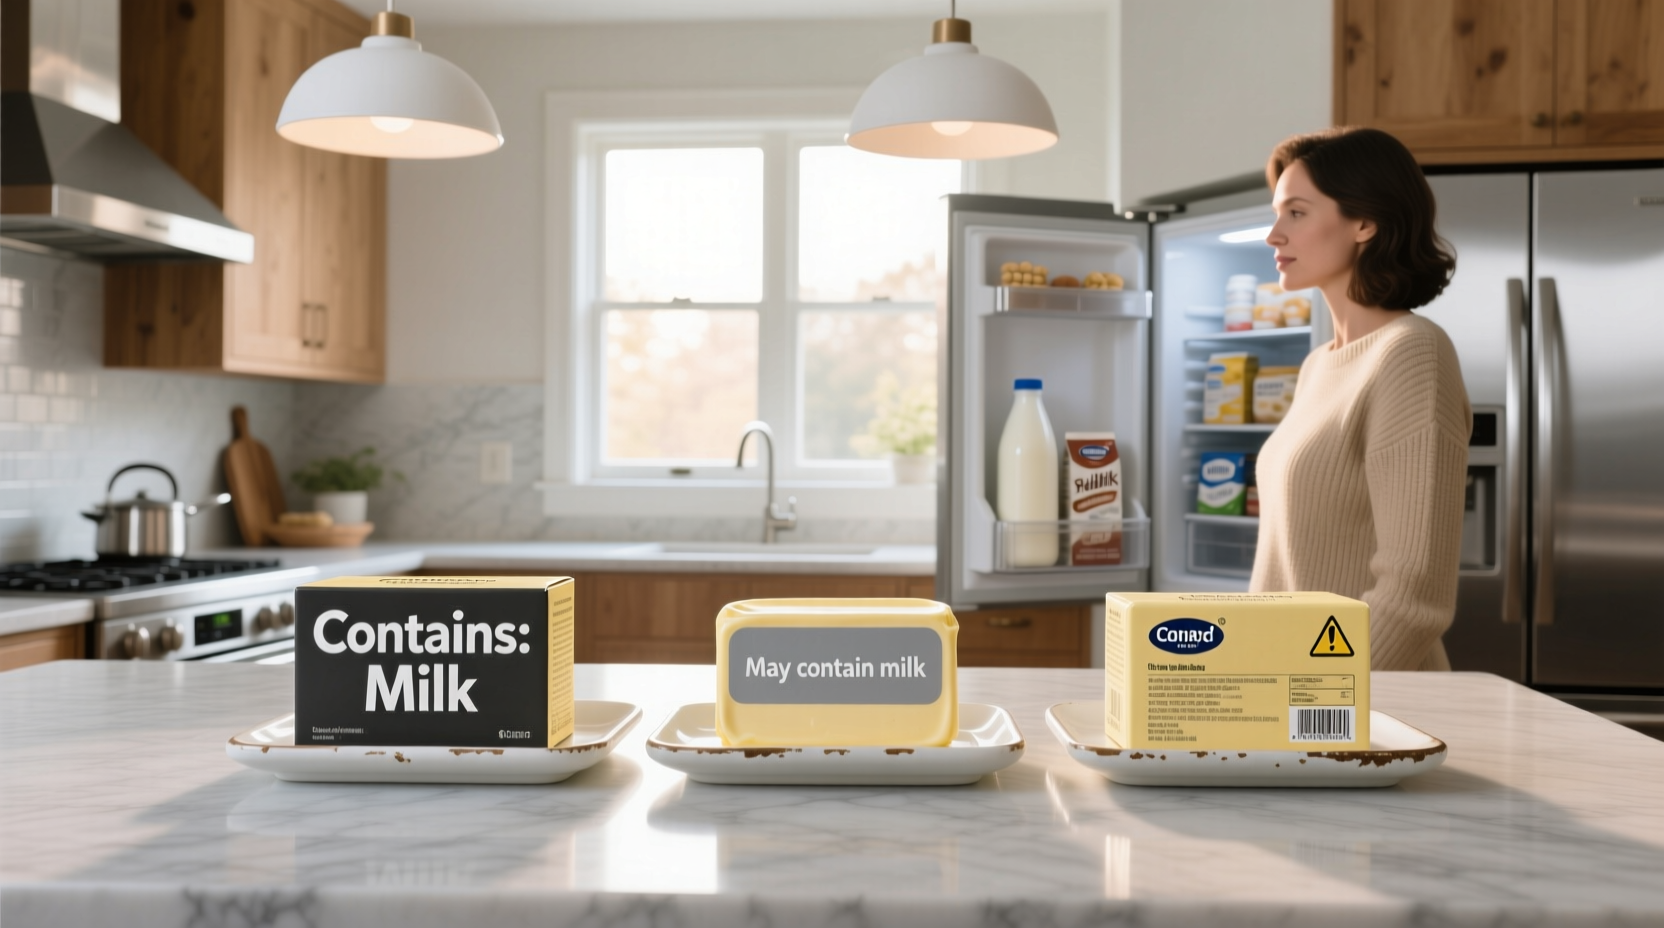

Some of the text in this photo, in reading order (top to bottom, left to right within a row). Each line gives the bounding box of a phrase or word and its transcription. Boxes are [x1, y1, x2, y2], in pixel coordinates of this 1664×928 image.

[313, 609, 531, 655] Contains:
[365, 663, 479, 713] Milk
[745, 655, 926, 684] May contain milk
